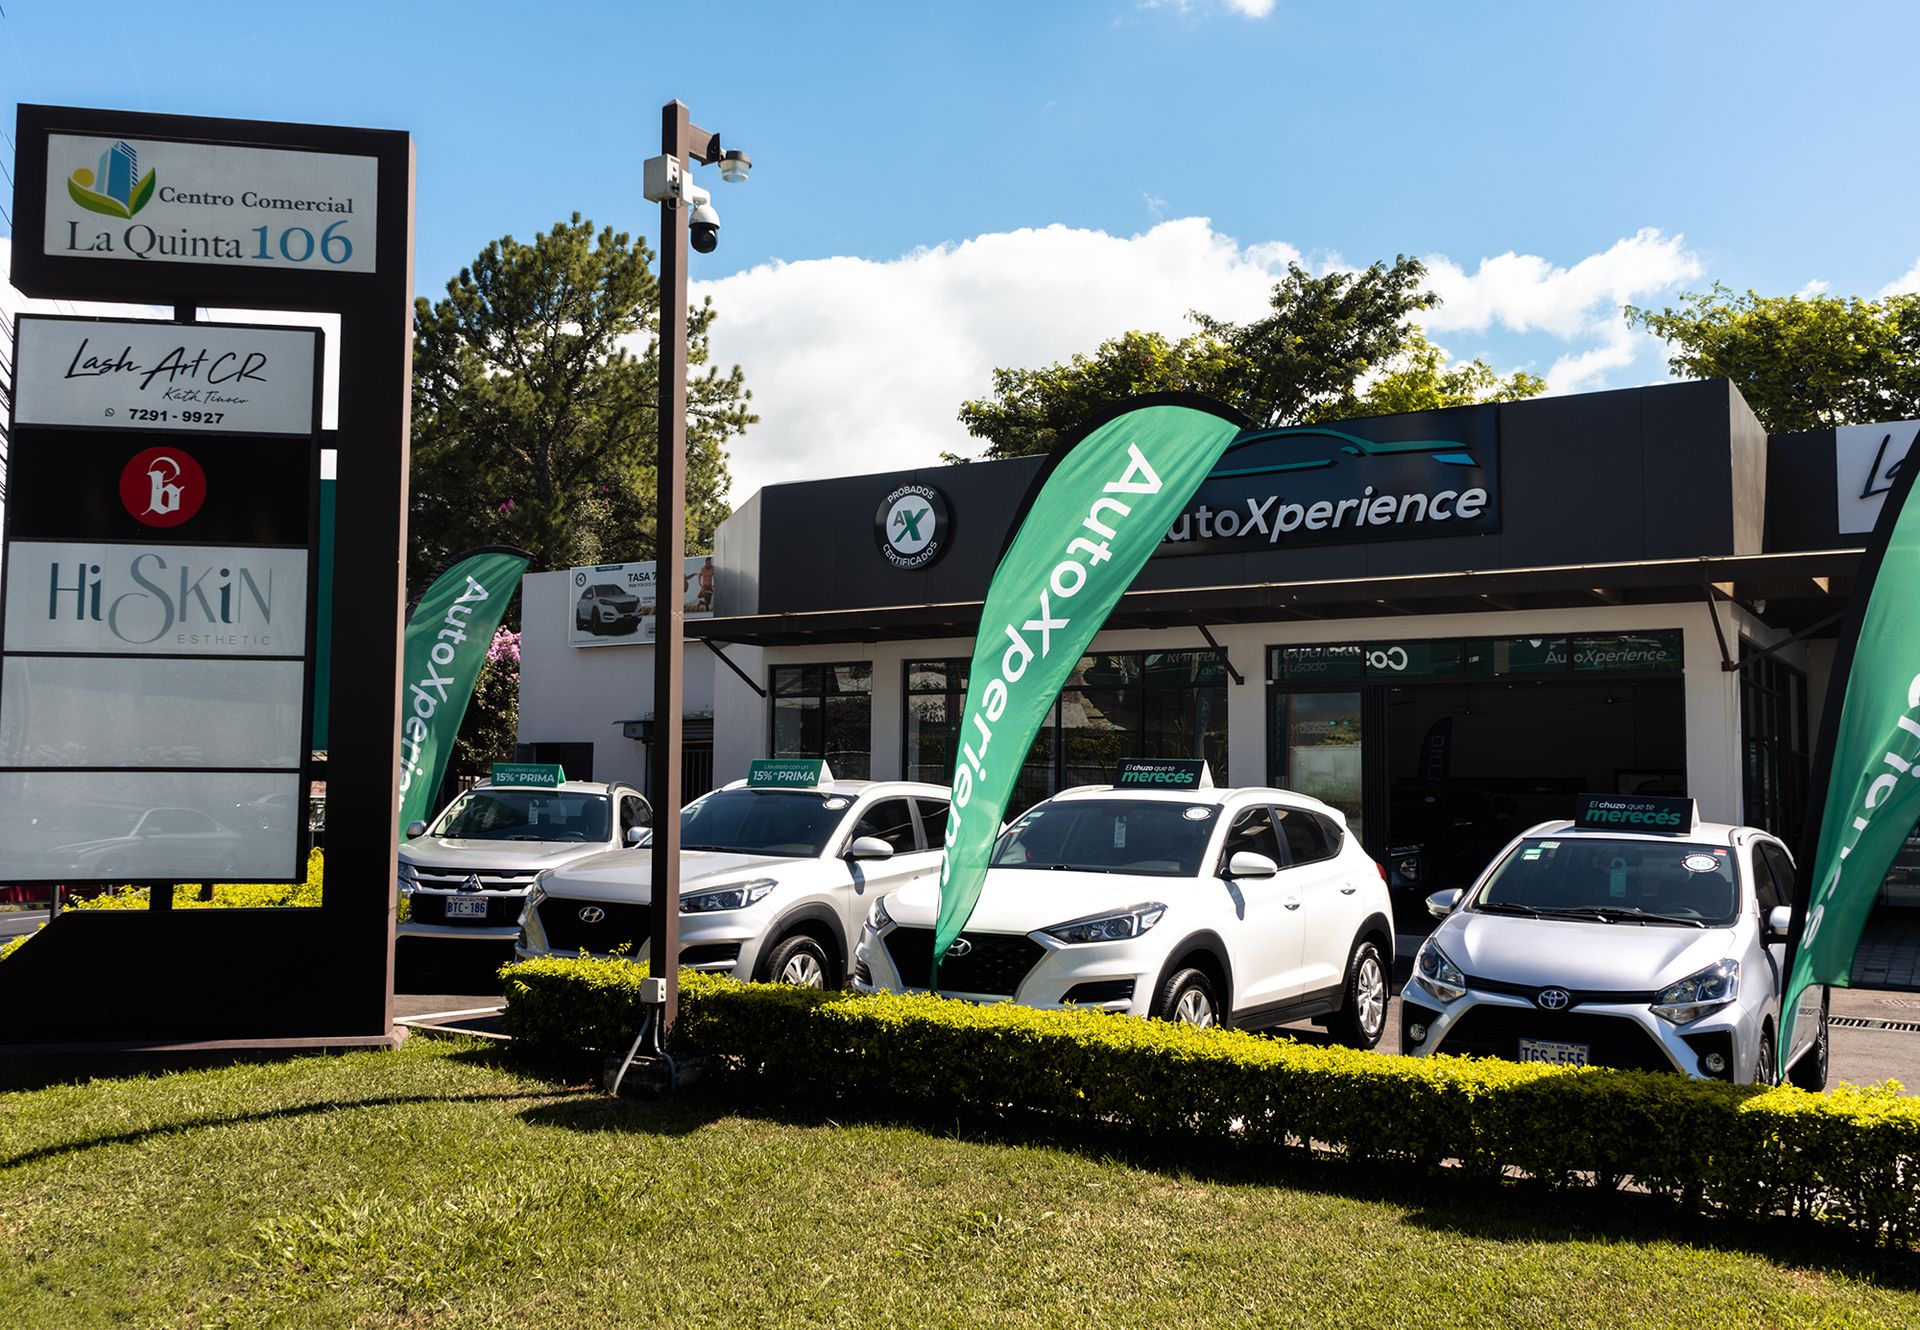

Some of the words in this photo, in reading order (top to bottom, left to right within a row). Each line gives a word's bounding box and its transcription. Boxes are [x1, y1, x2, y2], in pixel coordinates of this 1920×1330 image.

[158, 187, 235, 206] Centro
[241, 191, 354, 214] Comercial
[67, 221, 114, 252] La
[123, 224, 243, 260] Quinta
[251, 220, 354, 265] 106
[64, 338, 142, 379] Lash
[139, 347, 209, 390] Art
[207, 352, 267, 384] CR
[129, 408, 168, 421] 7291
[182, 411, 224, 424] 9927
[887, 485, 935, 504] PROBADOS
[1163, 486, 1488, 543] utoXperience
[883, 541, 938, 566] CERTIFICADOS
[628, 572, 651, 582] TASA
[49, 562, 104, 621] Hi
[177, 634, 272, 646] ESTHETIC
[1545, 648, 1667, 664] AuoXperience
[496, 772, 515, 782] 15%
[519, 773, 555, 783] PRIMA
[753, 770, 773, 781] 15%
[778, 771, 815, 781] PRIMA
[1121, 769, 1195, 784] merecés
[1589, 800, 1598, 808] El
[1598, 801, 1626, 809] chuzo
[1627, 803, 1645, 811] que
[1645, 803, 1655, 811] te
[1585, 808, 1681, 826] merecés
